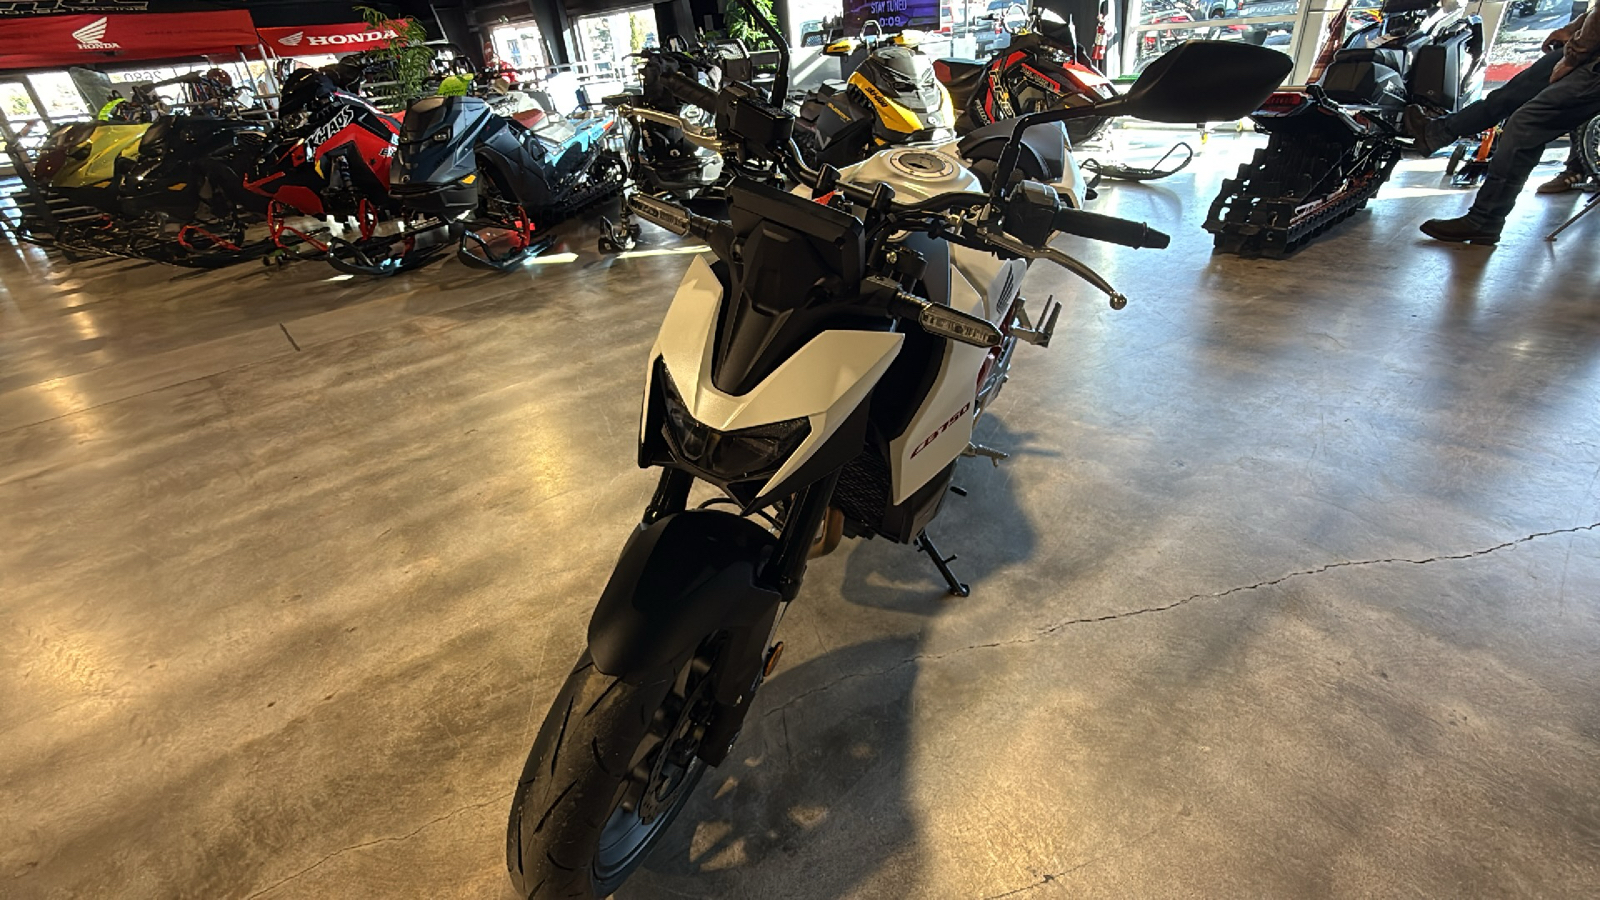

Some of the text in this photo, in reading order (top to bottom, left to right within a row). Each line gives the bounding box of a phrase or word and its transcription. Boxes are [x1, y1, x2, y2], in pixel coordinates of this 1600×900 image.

[871, 0, 907, 14] STAY TUNED
[76, 42, 122, 50] HONDA
[306, 29, 399, 46] HONDA
[304, 104, 354, 159] KHAOS
[909, 401, 971, 460] CB750
